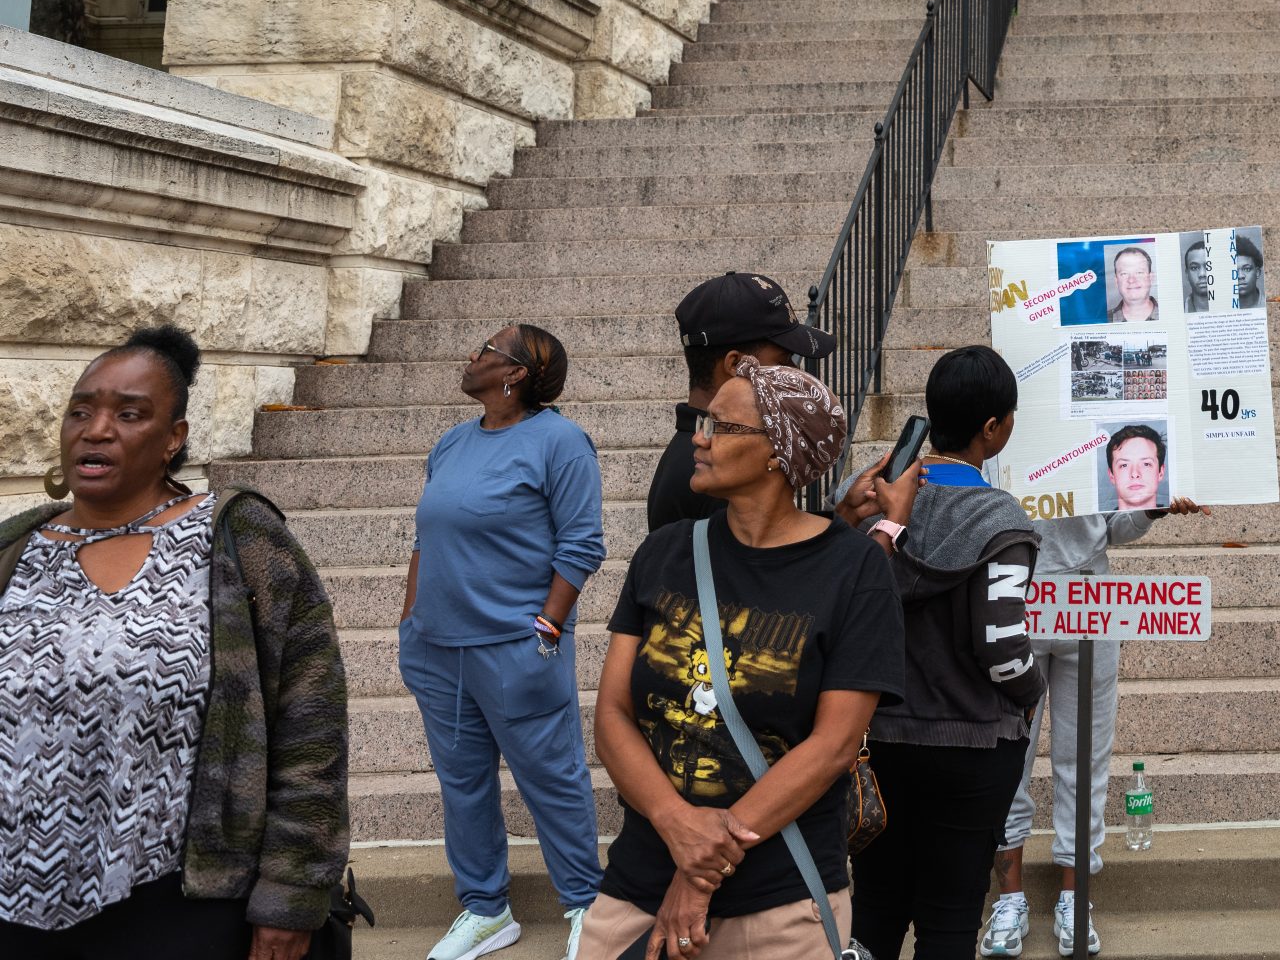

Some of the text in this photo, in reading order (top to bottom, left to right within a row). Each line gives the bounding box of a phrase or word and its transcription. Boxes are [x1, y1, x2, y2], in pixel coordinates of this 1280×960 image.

[1205, 232, 1215, 301] TYSON
[1229, 229, 1240, 309] JAYDEN
[1023, 289, 1056, 310] SECOND
[1057, 272, 1094, 294] CHANCES
[1029, 305, 1055, 322] GIVEN
[1201, 388, 1257, 420] 40 yrs
[1205, 430, 1256, 439] SIMPLY UNFAIR
[1028, 433, 1108, 482] #WHYCANTOURKIDS
[1015, 491, 1075, 520] SON
[1025, 581, 1202, 606] OR ENTRANCE
[1053, 611, 1112, 635] ALLEY
[1137, 612, 1202, 636] ANNEX
[1127, 794, 1152, 810] Sprit
